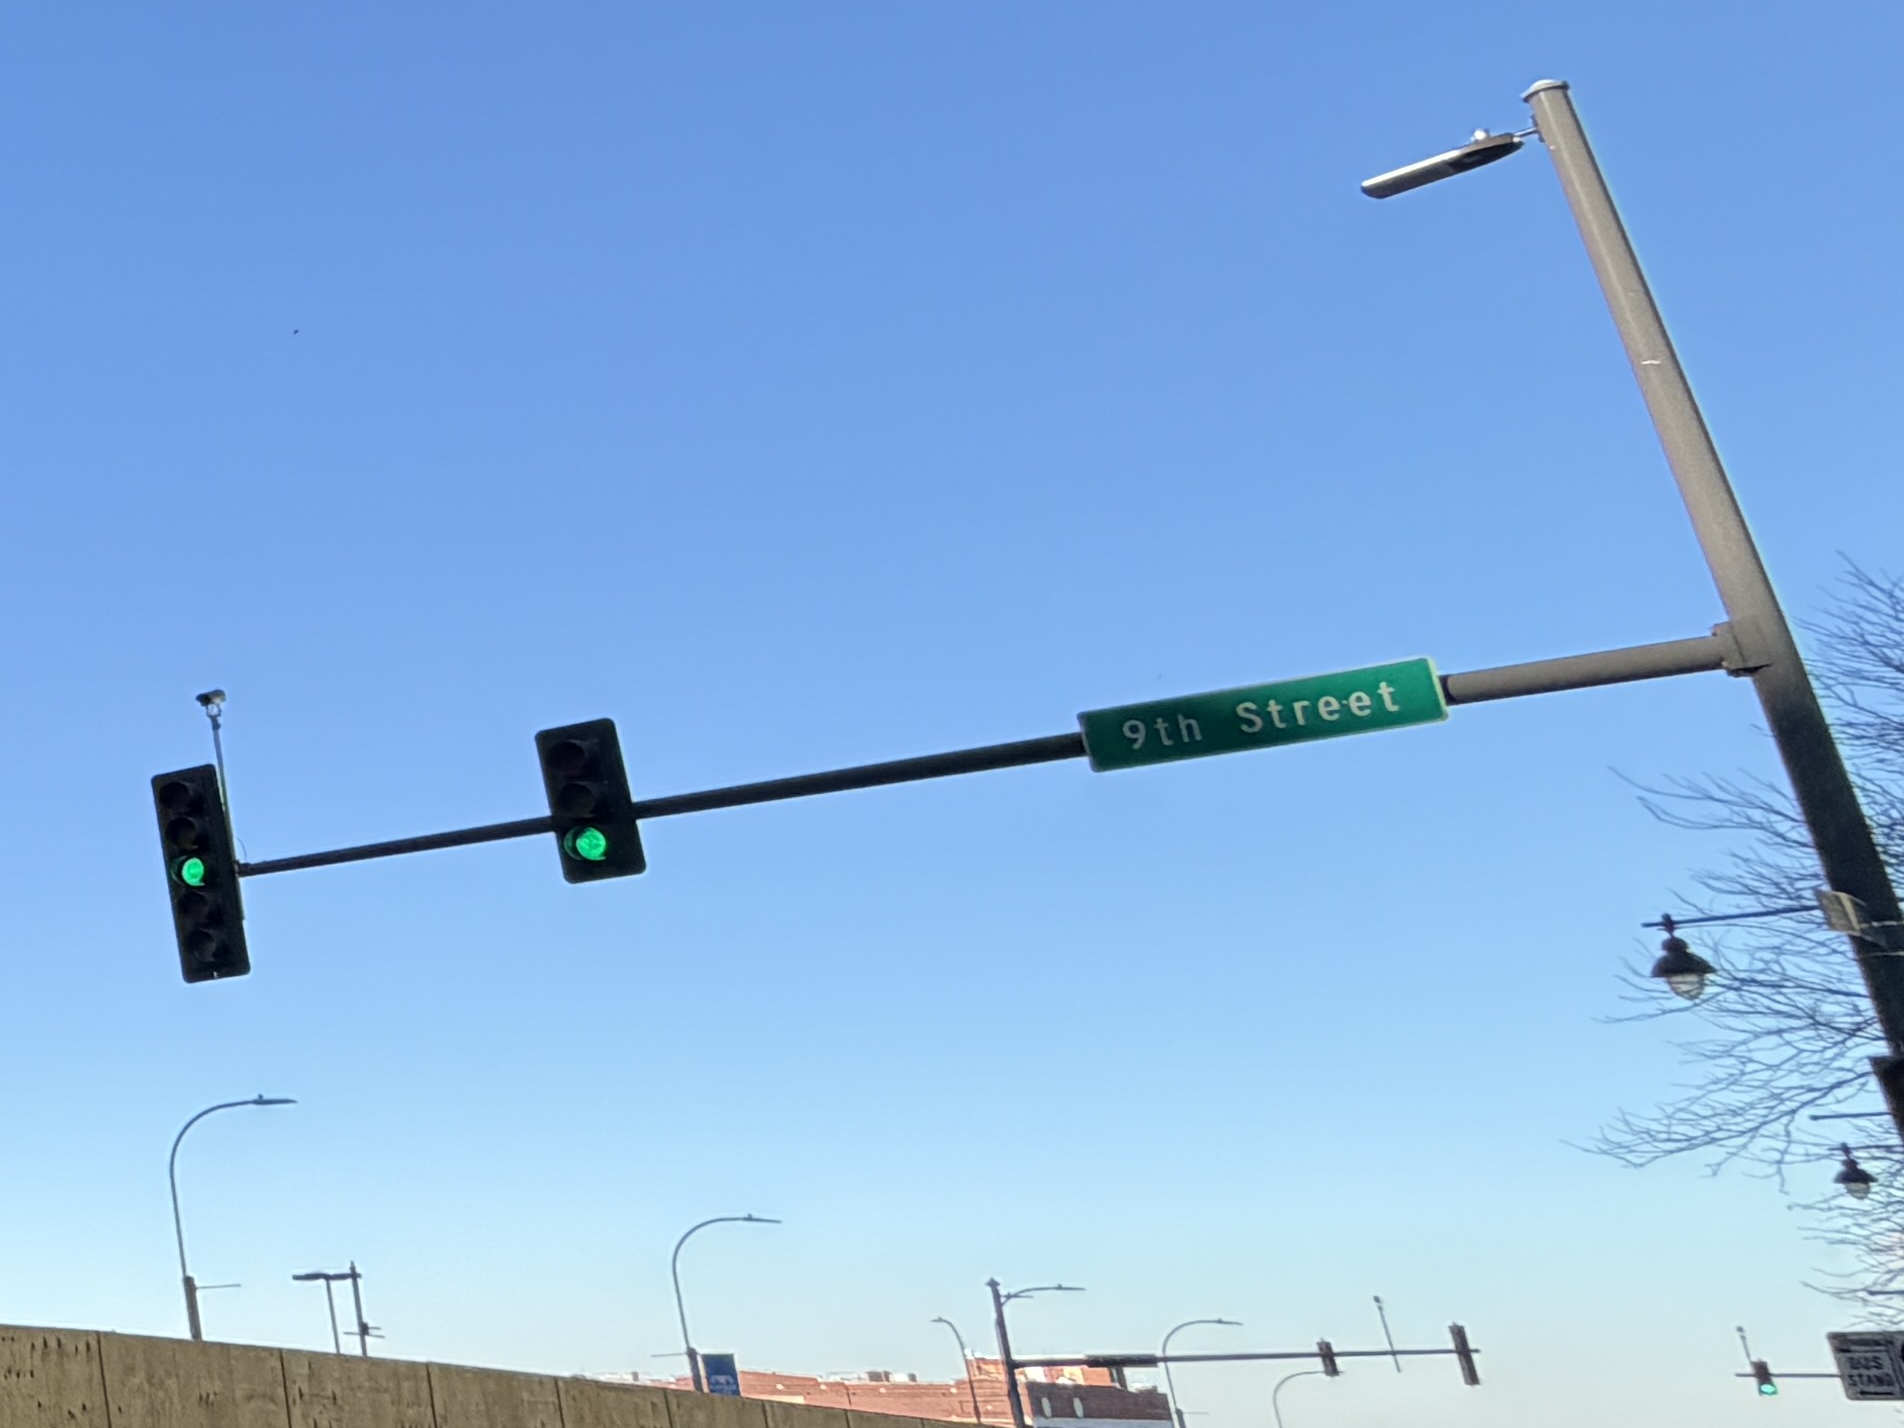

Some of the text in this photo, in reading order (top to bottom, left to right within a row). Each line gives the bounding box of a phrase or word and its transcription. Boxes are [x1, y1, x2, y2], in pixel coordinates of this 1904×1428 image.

[1122, 681, 1400, 750] 9th Street
[1847, 1355, 1883, 1370] BUS
